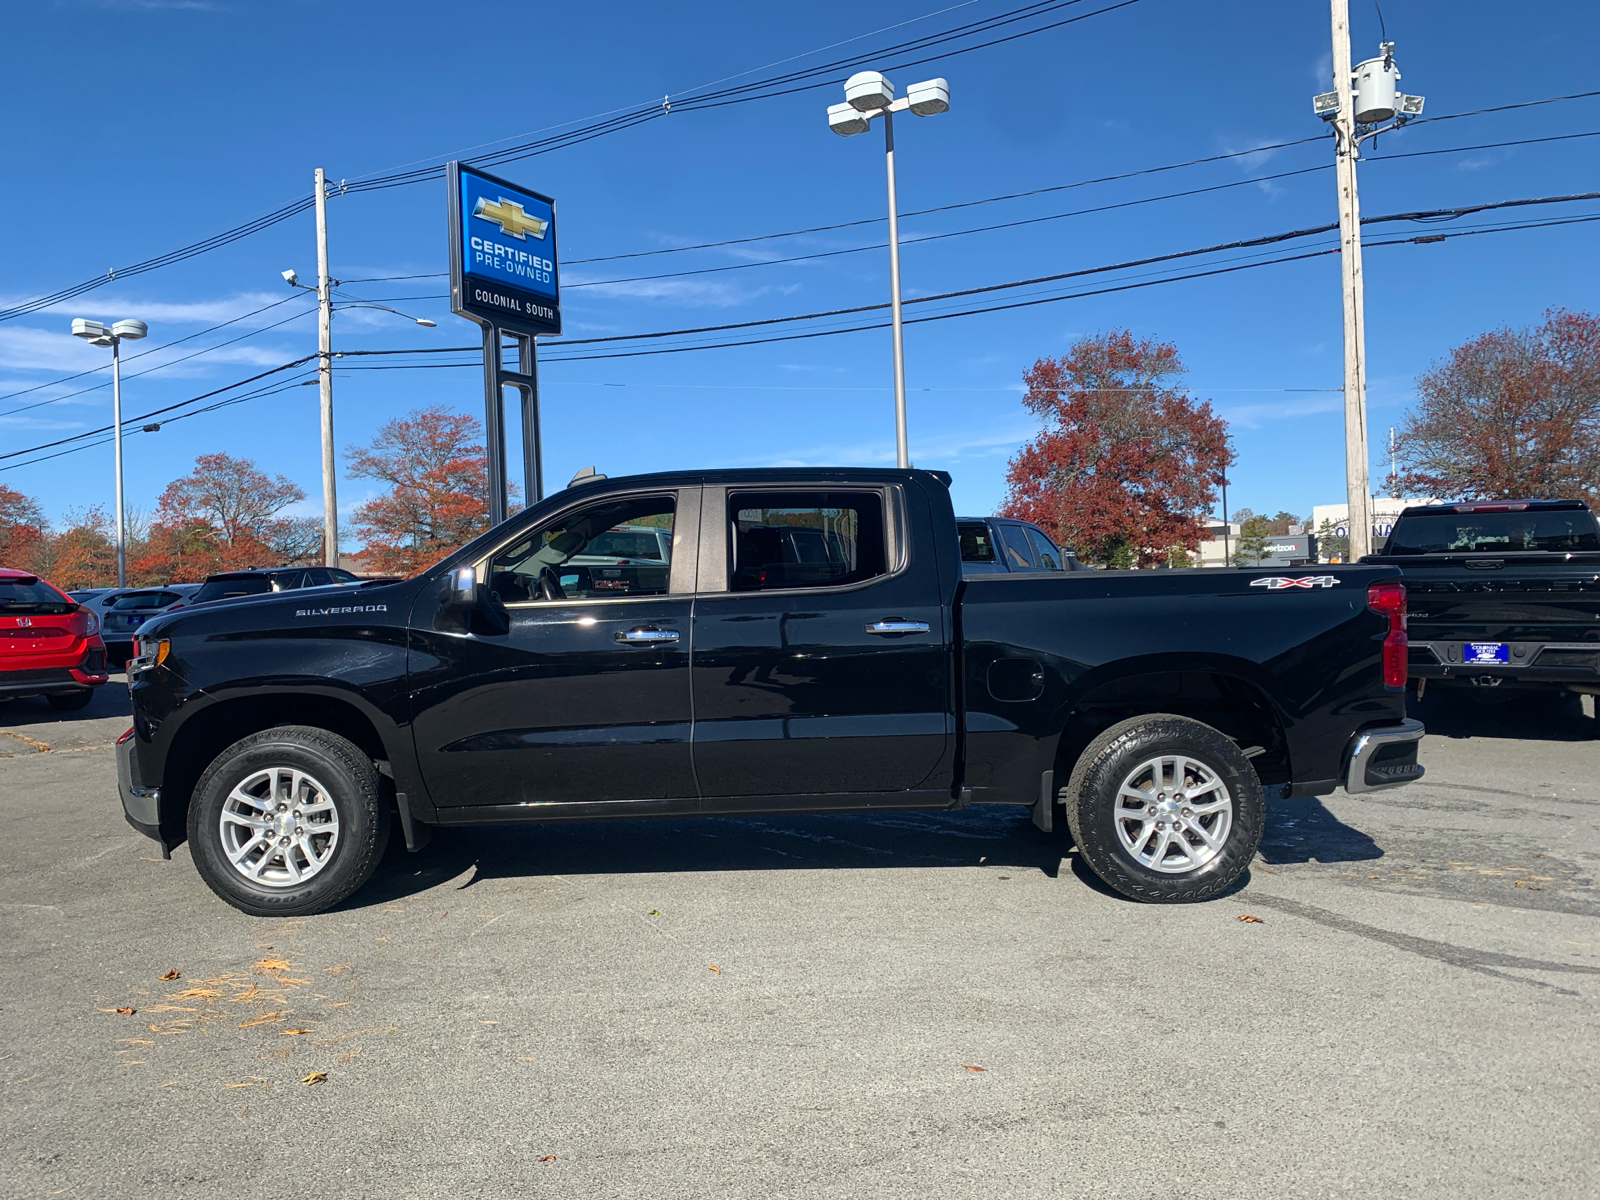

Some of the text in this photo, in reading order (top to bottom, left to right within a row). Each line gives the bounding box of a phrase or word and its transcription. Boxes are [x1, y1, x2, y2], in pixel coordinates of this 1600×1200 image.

[471, 236, 553, 272] CERTIFIED
[476, 251, 550, 284] PRE-OWNED
[475, 289, 554, 320] COLONIAL SOUTH
[1263, 543, 1297, 552] verizon
[594, 580, 630, 589] GMC
[294, 604, 388, 617] SILVERADO
